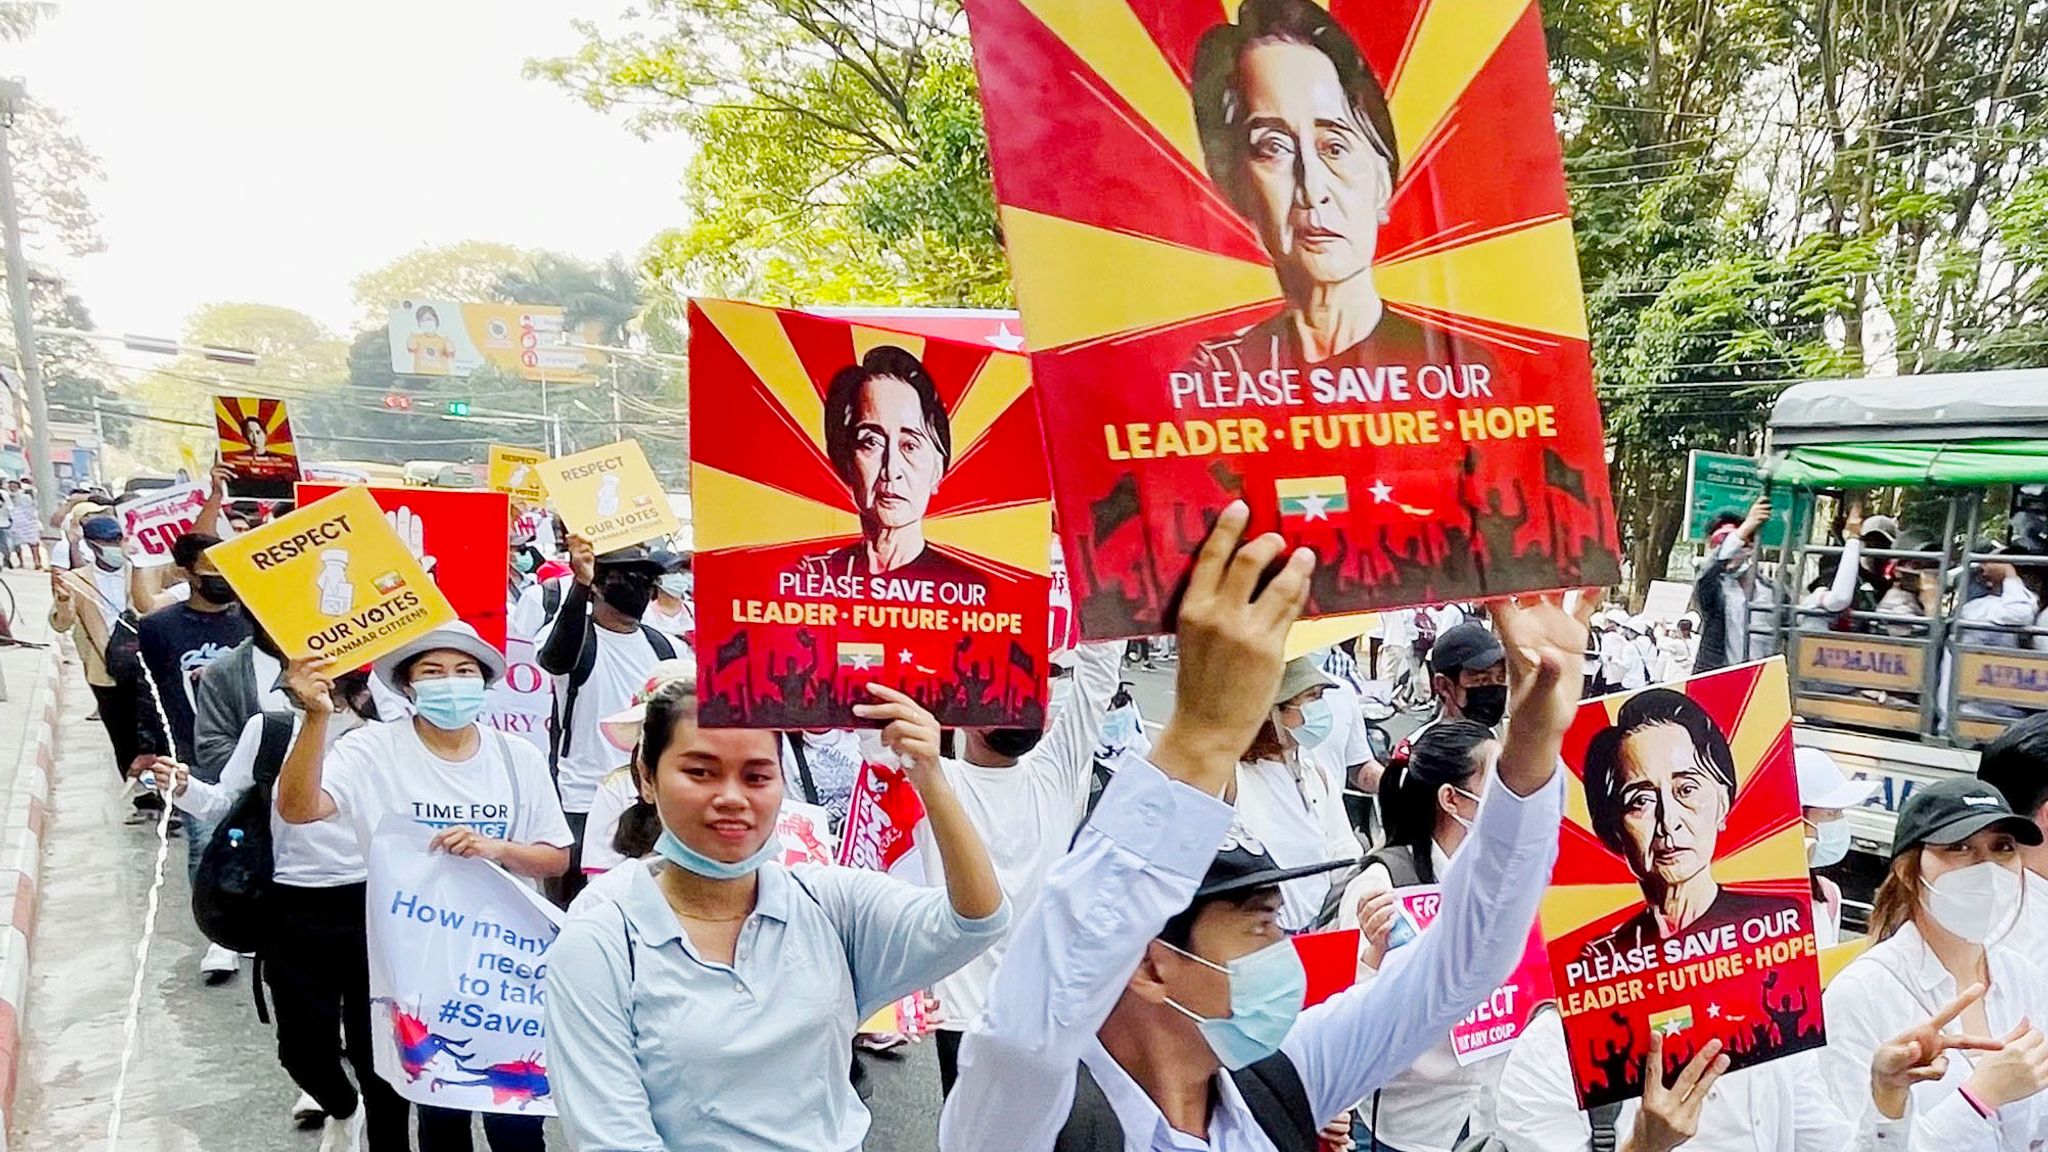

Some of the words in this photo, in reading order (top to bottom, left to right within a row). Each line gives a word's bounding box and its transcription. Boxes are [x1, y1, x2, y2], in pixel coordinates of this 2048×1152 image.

[1170, 368, 1304, 410] PLEASE
[1311, 366, 1410, 404] SAVE
[1417, 363, 1493, 400] OUR
[1104, 417, 1269, 461] LEADER
[1291, 408, 1440, 452] FUTURE
[1459, 405, 1558, 441] HOPE
[561, 456, 625, 482] RESPECT
[251, 515, 352, 570] RESPECT
[584, 520, 616, 537] OUR
[616, 507, 660, 528] VOTES
[779, 572, 865, 600] PLEASE
[870, 580, 934, 603] SAVE
[939, 582, 986, 607] OUR
[307, 622, 353, 651] OUR
[351, 591, 419, 630] VOTES
[321, 632, 377, 659] YANMAR
[379, 609, 429, 637] CITIZENS
[732, 599, 837, 627] LEADER
[853, 605, 949, 631] FUTURE
[962, 610, 1022, 635] HOPE
[411, 802, 464, 819] TIME
[471, 804, 508, 819] FOR
[390, 891, 465, 930] How
[471, 919, 550, 957] many
[1566, 944, 1659, 988] PLEASE
[1663, 924, 1738, 965] SAVE
[1742, 908, 1801, 943] OUR
[459, 972, 490, 997] to
[498, 979, 546, 1007] tak
[1556, 978, 1645, 1018] LEADER
[1656, 953, 1744, 994] FUTURE
[1755, 934, 1816, 970] HOPE
[1489, 1022, 1517, 1042] COUP
